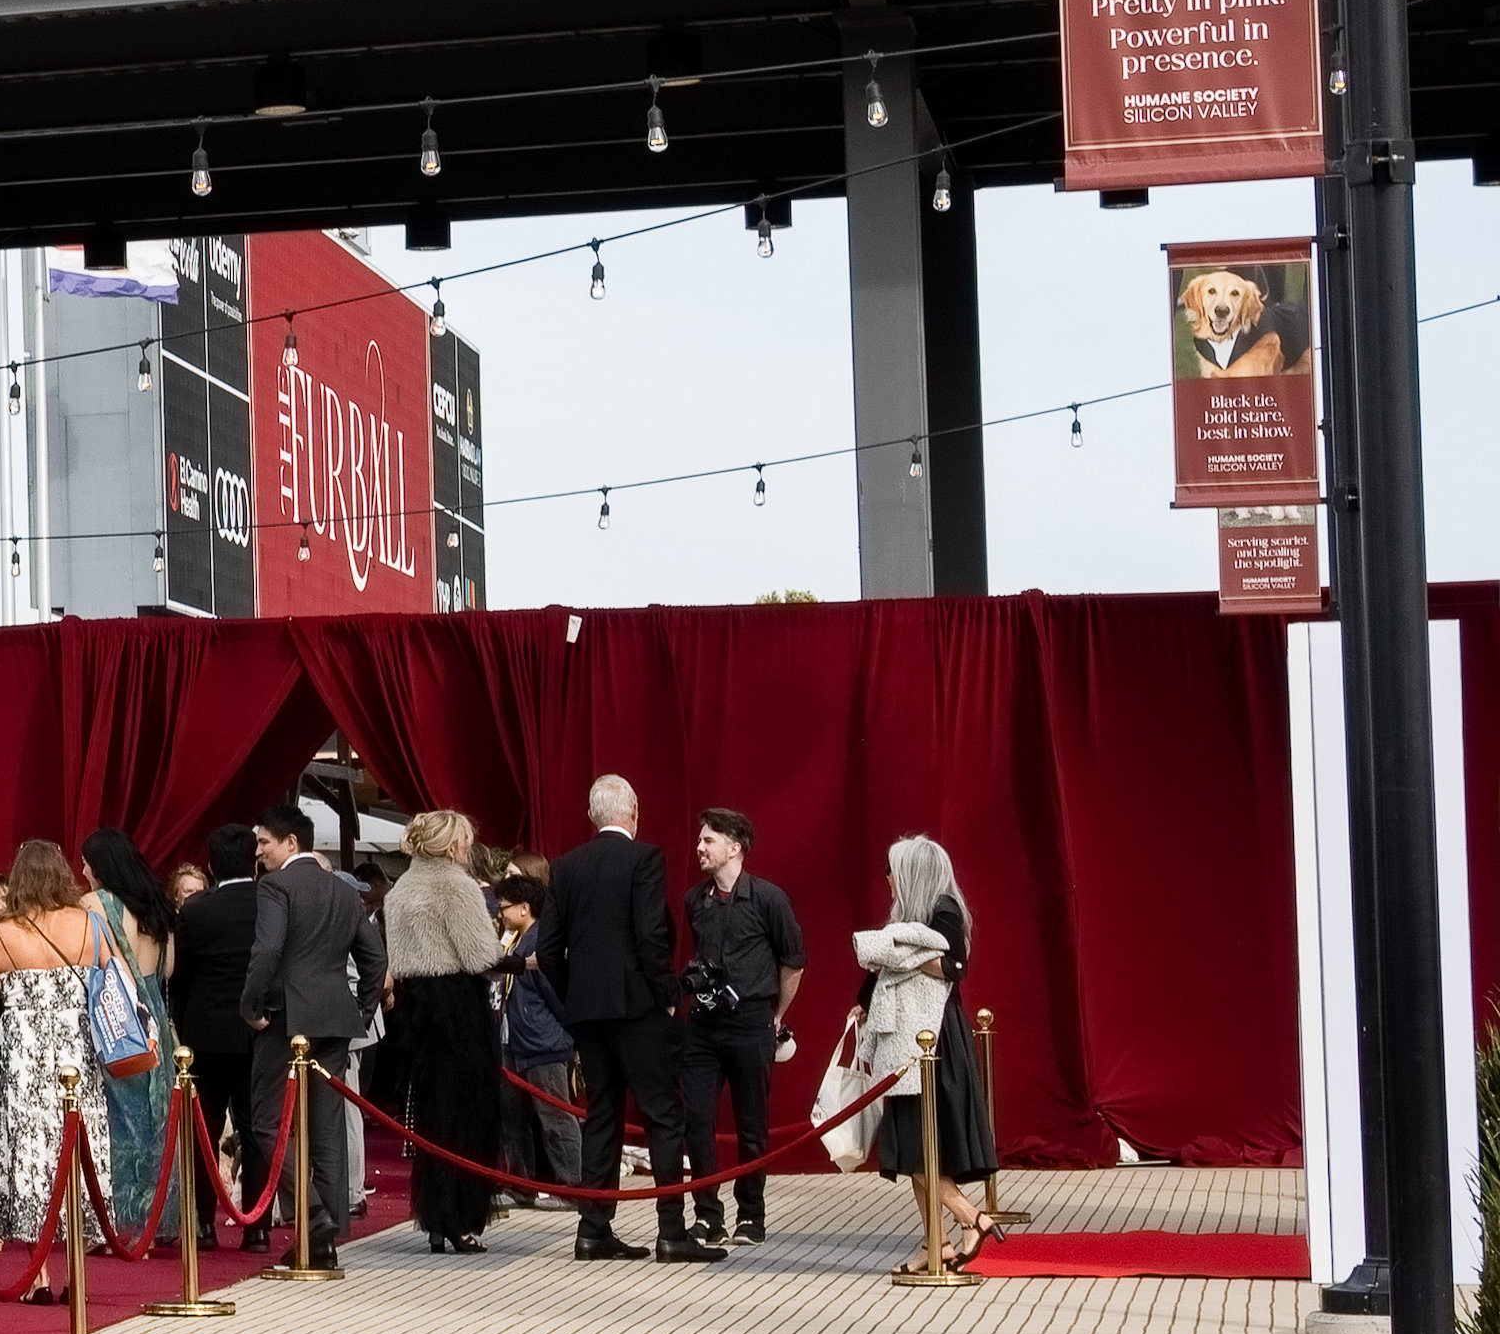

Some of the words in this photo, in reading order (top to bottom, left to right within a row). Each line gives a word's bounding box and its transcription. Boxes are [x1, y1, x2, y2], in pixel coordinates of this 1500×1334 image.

[1110, 18, 1235, 49] Powerful
[1244, 18, 1269, 40] in
[1122, 48, 1259, 80] presence.
[1124, 92, 1190, 107] HUMANE
[1193, 87, 1258, 102] SOCIETY
[1124, 105, 1192, 124] SILICON
[1197, 101, 1258, 119] VALLEY
[1211, 394, 1251, 408] Black
[1254, 393, 1277, 407] tie,
[1204, 410, 1238, 424] bold
[1241, 410, 1285, 423] stare,
[1197, 426, 1231, 440] best
[1234, 425, 1248, 439] in
[1251, 424, 1293, 438] show.
[1208, 454, 1246, 464] HUMANE
[1247, 453, 1284, 462] SOCIETY
[288, 339, 416, 593] FURBALL
[1208, 462, 1247, 473] SILICON
[1249, 461, 1284, 471] VALLEY
[1227, 537, 1268, 548] Serving
[1236, 548, 1257, 558] and
[1259, 547, 1300, 558] stealing
[1234, 559, 1252, 569] the
[1254, 557, 1303, 570] spotlight.
[1270, 576, 1296, 584] SOCIETY
